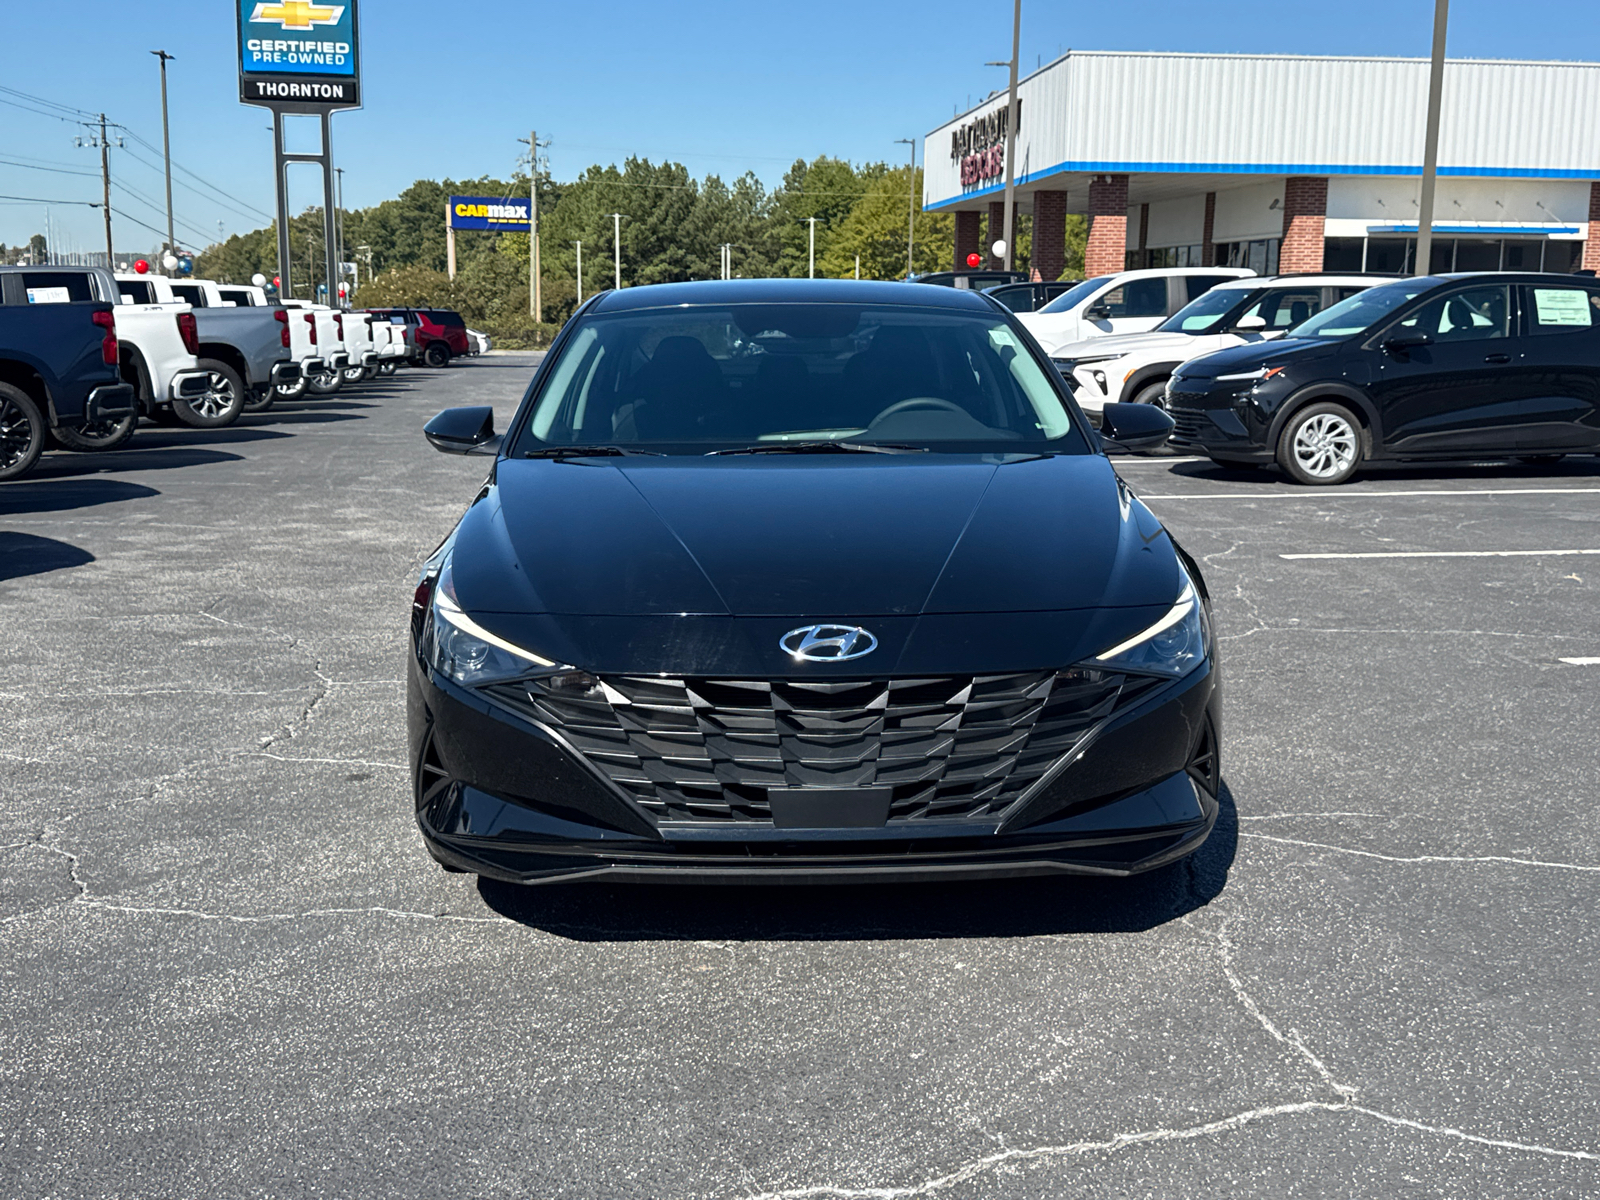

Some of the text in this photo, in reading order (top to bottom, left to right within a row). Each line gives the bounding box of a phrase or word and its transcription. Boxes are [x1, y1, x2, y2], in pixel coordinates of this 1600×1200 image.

[247, 39, 350, 54] CERTIFIED
[252, 51, 345, 66] PRE-OWNED
[256, 82, 344, 98] THORNTON
